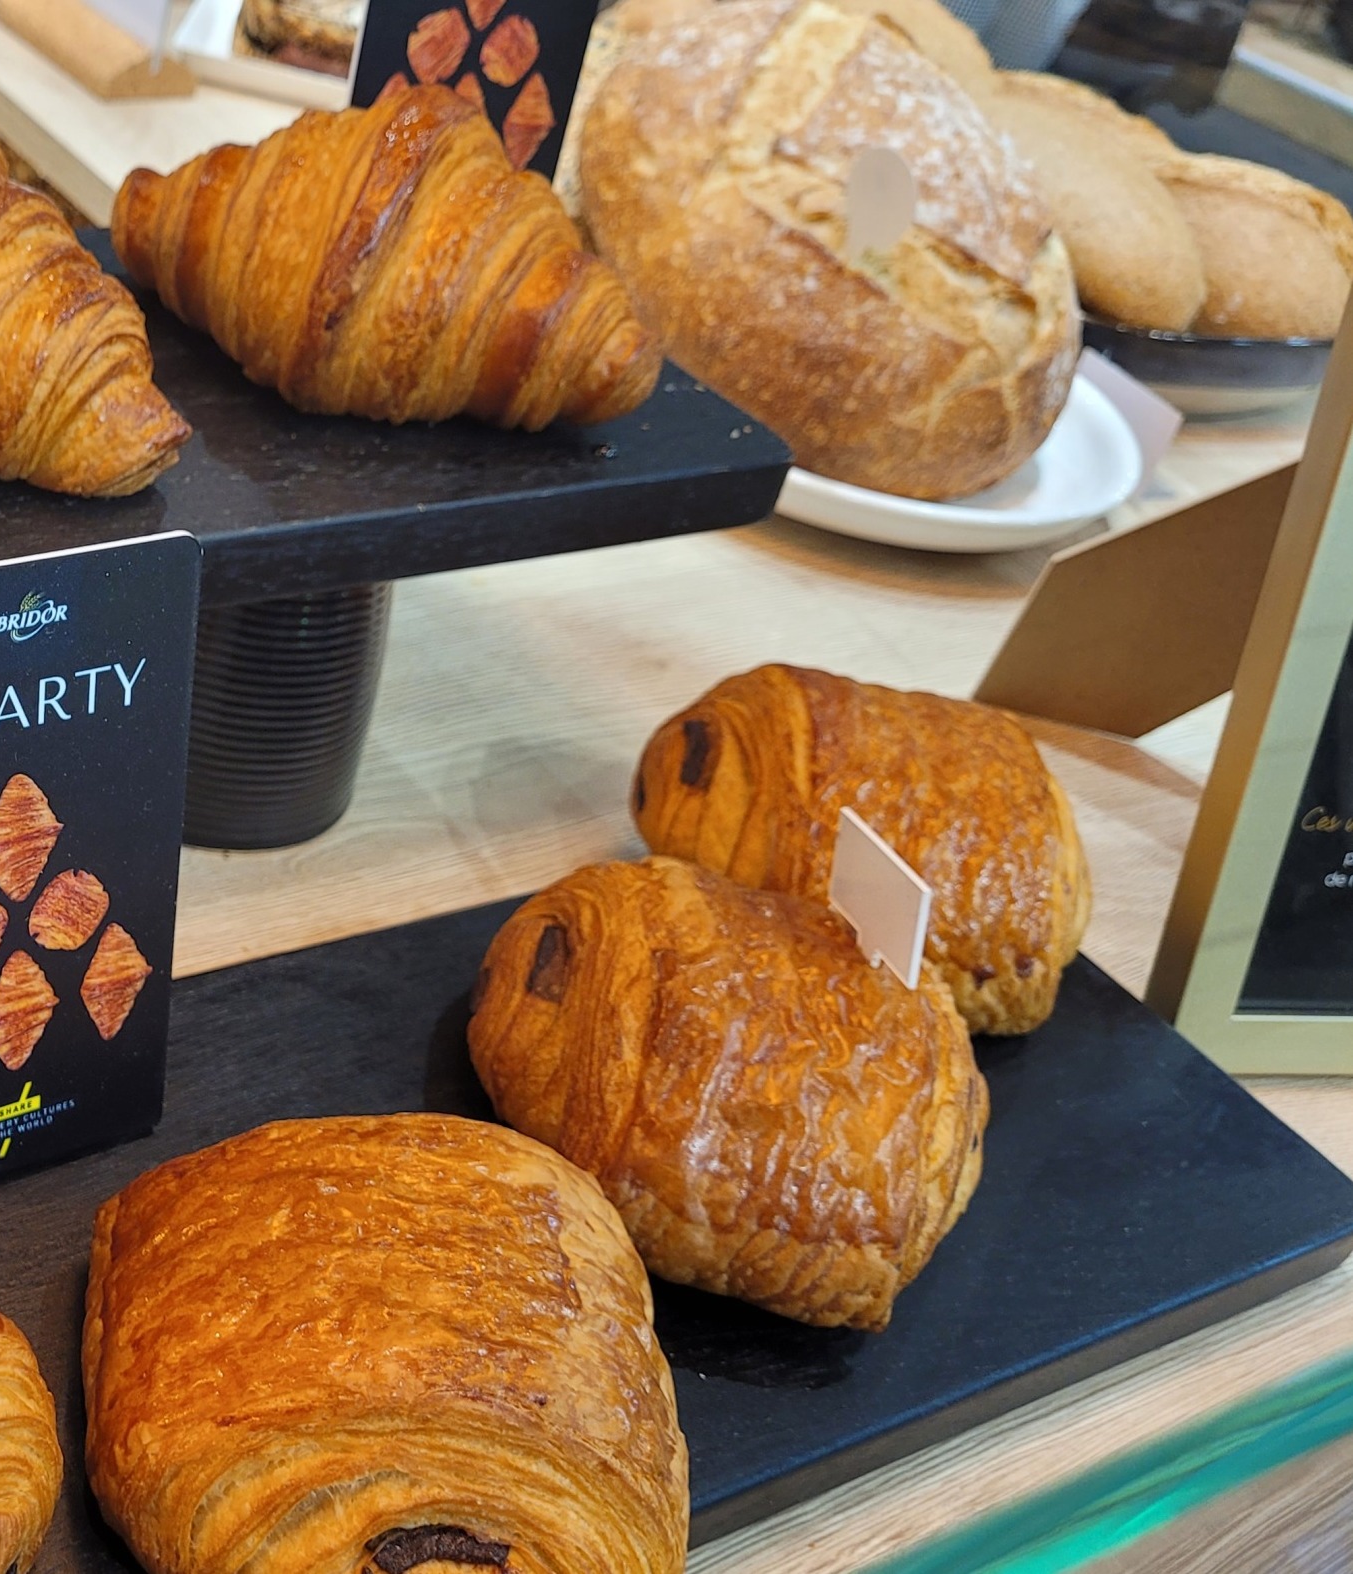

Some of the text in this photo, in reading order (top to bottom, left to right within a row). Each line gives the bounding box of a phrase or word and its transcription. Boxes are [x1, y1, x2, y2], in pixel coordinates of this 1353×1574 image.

[0, 1100, 32, 1117] SHARE
[22, 1099, 75, 1122] CULTURES
[17, 1115, 53, 1133] WORLD
